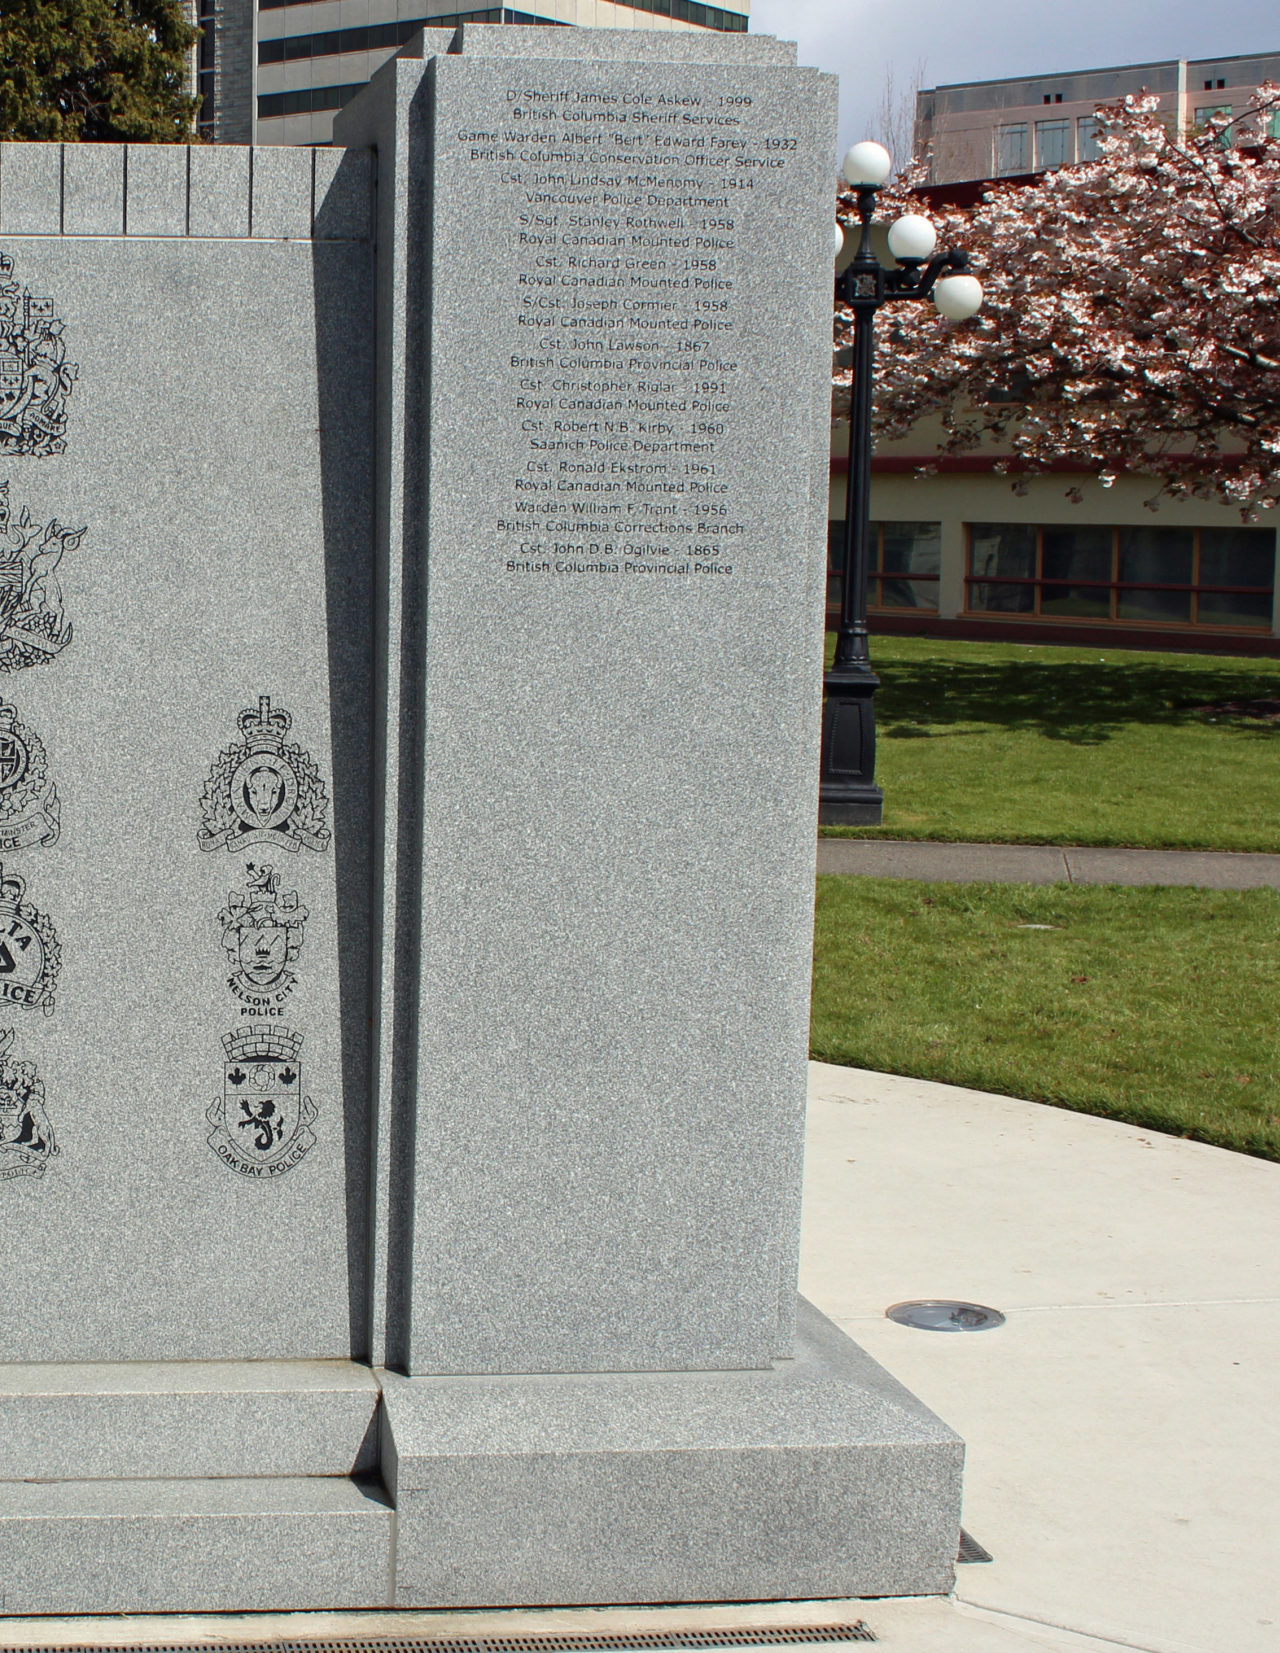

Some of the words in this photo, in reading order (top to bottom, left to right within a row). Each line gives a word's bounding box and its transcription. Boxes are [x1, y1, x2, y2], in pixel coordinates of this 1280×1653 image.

[573, 92, 618, 104] James
[622, 93, 653, 105] Cole
[718, 95, 752, 107] 1999
[513, 108, 557, 121] British
[562, 110, 627, 123] Columbia
[632, 111, 677, 124] Sheriff
[682, 112, 740, 125] Services
[457, 130, 499, 143] Game
[503, 131, 557, 144] Warden
[561, 133, 603, 145] Albert
[654, 135, 705, 148] Edward
[763, 138, 798, 150] 1932
[471, 150, 515, 162] British
[519, 151, 584, 163] Columbia
[590, 152, 681, 166] Conservation
[684, 154, 729, 167] Officer
[734, 155, 785, 168] Service
[526, 192, 598, 205] Vancouver
[603, 194, 643, 206] Police
[647, 195, 729, 210] Department
[519, 232, 557, 248] Royal
[562, 233, 626, 246] Canadian
[631, 235, 690, 248] Mounted
[695, 236, 735, 249] Police
[568, 256, 620, 269] Richard
[625, 257, 667, 270] Green
[683, 258, 717, 270] 1958
[570, 297, 618, 312] Joseph
[694, 299, 728, 312] 1958
[510, 356, 554, 368] British
[559, 357, 624, 369] Columbia
[628, 358, 694, 370] Provincial
[699, 359, 737, 371] Police
[552, 379, 632, 395] Christopher
[693, 382, 727, 394] 1991
[530, 439, 584, 451] Saanich
[589, 440, 628, 452] Police
[633, 440, 715, 455] Department
[559, 461, 605, 473] Ronald
[684, 463, 717, 475] 1961
[514, 479, 552, 494] Royal
[557, 480, 621, 492] Canadian
[626, 481, 685, 493] Mounted
[690, 482, 728, 493] Police
[514, 502, 566, 514] Warden
[572, 502, 621, 514] William
[694, 504, 727, 515] 1956
[497, 520, 540, 532] British
[545, 520, 609, 533] Columbia
[614, 521, 693, 533] Corrections
[697, 522, 744, 534] Branch
[551, 543, 584, 555] John
[687, 544, 720, 556] 1865
[506, 561, 550, 573] British
[555, 561, 619, 573] Columbia
[624, 562, 689, 574] Provincial
[694, 562, 733, 574] Police
[227, 977, 270, 1006] NELSON
[276, 977, 298, 1002] CITY
[241, 1007, 284, 1016] POLICE
[218, 1144, 240, 1168] OAK
[240, 1163, 263, 1176] BAY
[269, 1143, 307, 1175] POLICE
[2, 1168, 38, 1179] POLICE
